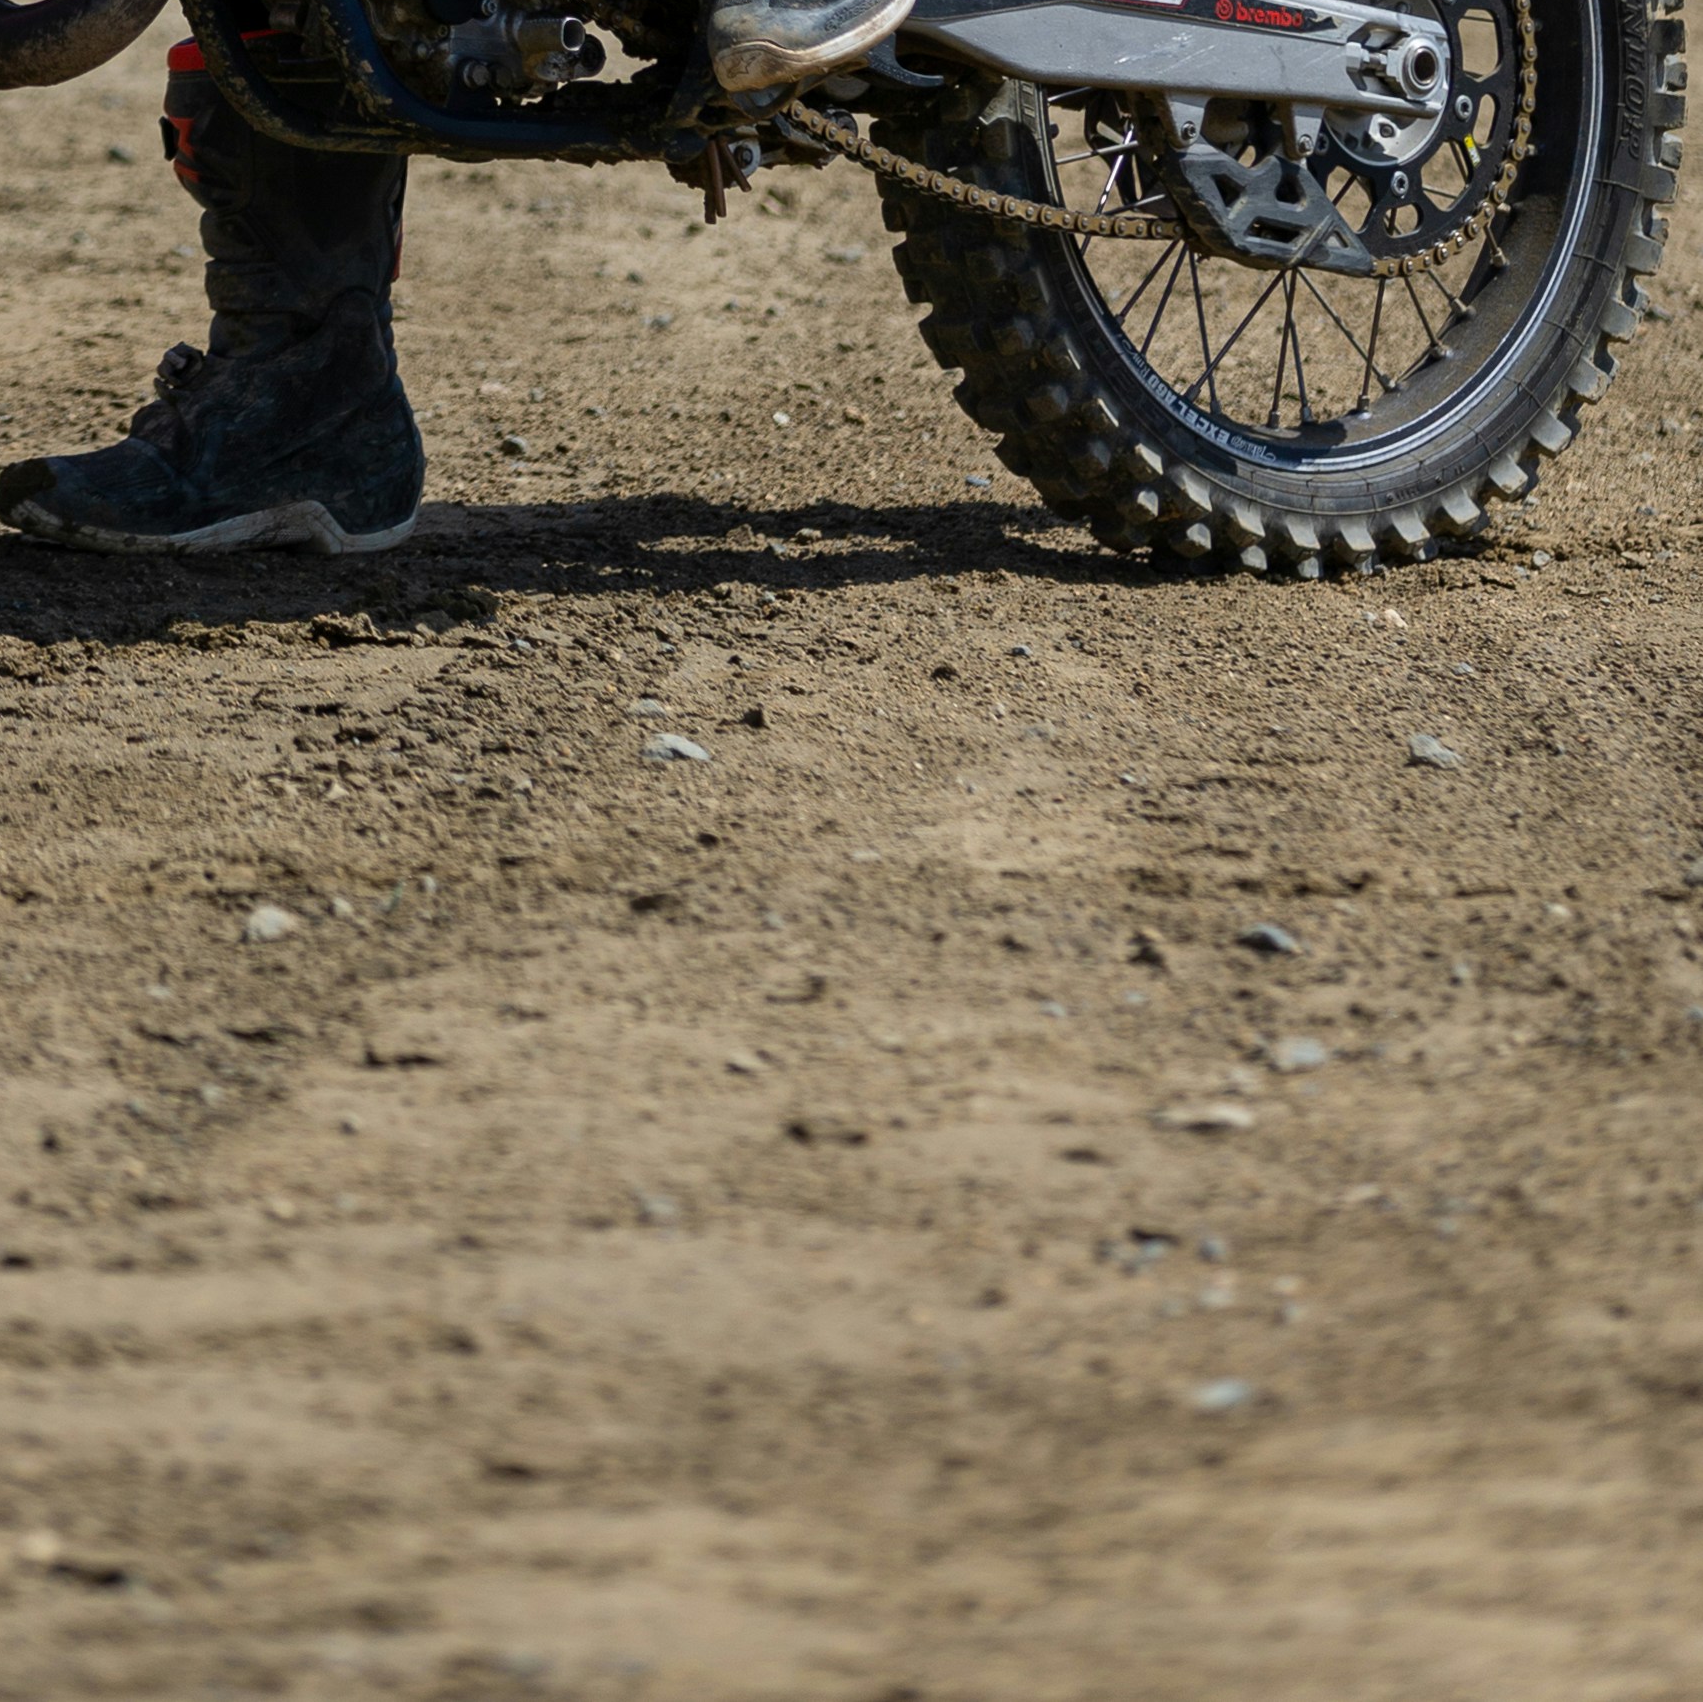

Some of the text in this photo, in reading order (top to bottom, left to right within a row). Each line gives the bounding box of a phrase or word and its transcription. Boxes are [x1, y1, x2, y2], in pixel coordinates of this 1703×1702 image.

[1235, 0, 1305, 28] brembo
[1146, 381, 1178, 409] A60
[1176, 405, 1230, 446] EXCEL
